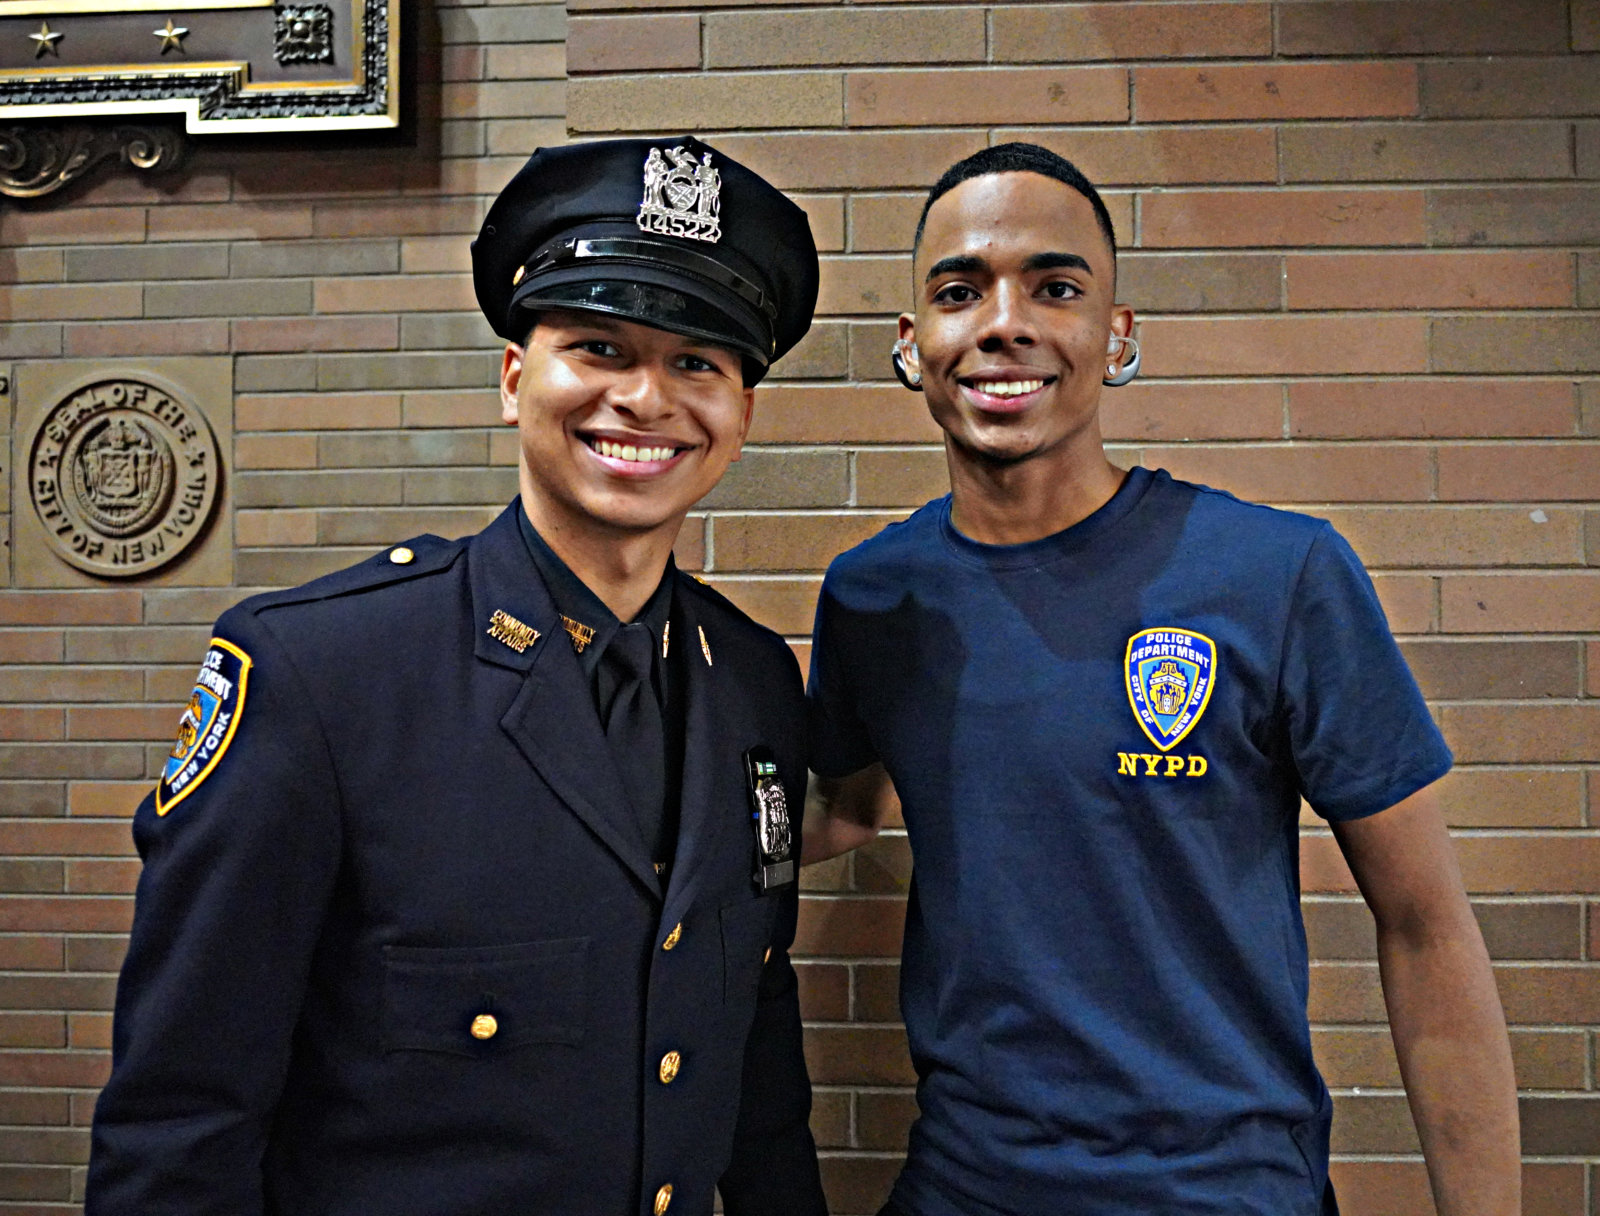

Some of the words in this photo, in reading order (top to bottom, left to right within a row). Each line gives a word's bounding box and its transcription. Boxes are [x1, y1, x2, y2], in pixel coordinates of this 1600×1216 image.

[645, 213, 717, 242] 14522
[45, 389, 106, 442] SEAL
[111, 383, 147, 407] OF
[154, 397, 197, 442] THE
[38, 479, 75, 535] CITY
[72, 533, 104, 559] OF
[112, 533, 166, 564] NEW
[164, 473, 207, 537] YORK
[487, 626, 528, 654] AFFAIRS
[493, 609, 542, 642] COMMUNITY
[1146, 633, 1192, 646] POLICE
[1131, 644, 1210, 669] DEPARTMENT
[1131, 674, 1145, 703] CITY
[1140, 709, 1154, 725] OF
[1170, 712, 1192, 737] NEW
[1190, 677, 1208, 706] YORK
[171, 759, 199, 794] NEW
[197, 712, 232, 759] YORK
[1117, 752, 1208, 778] NYPD
